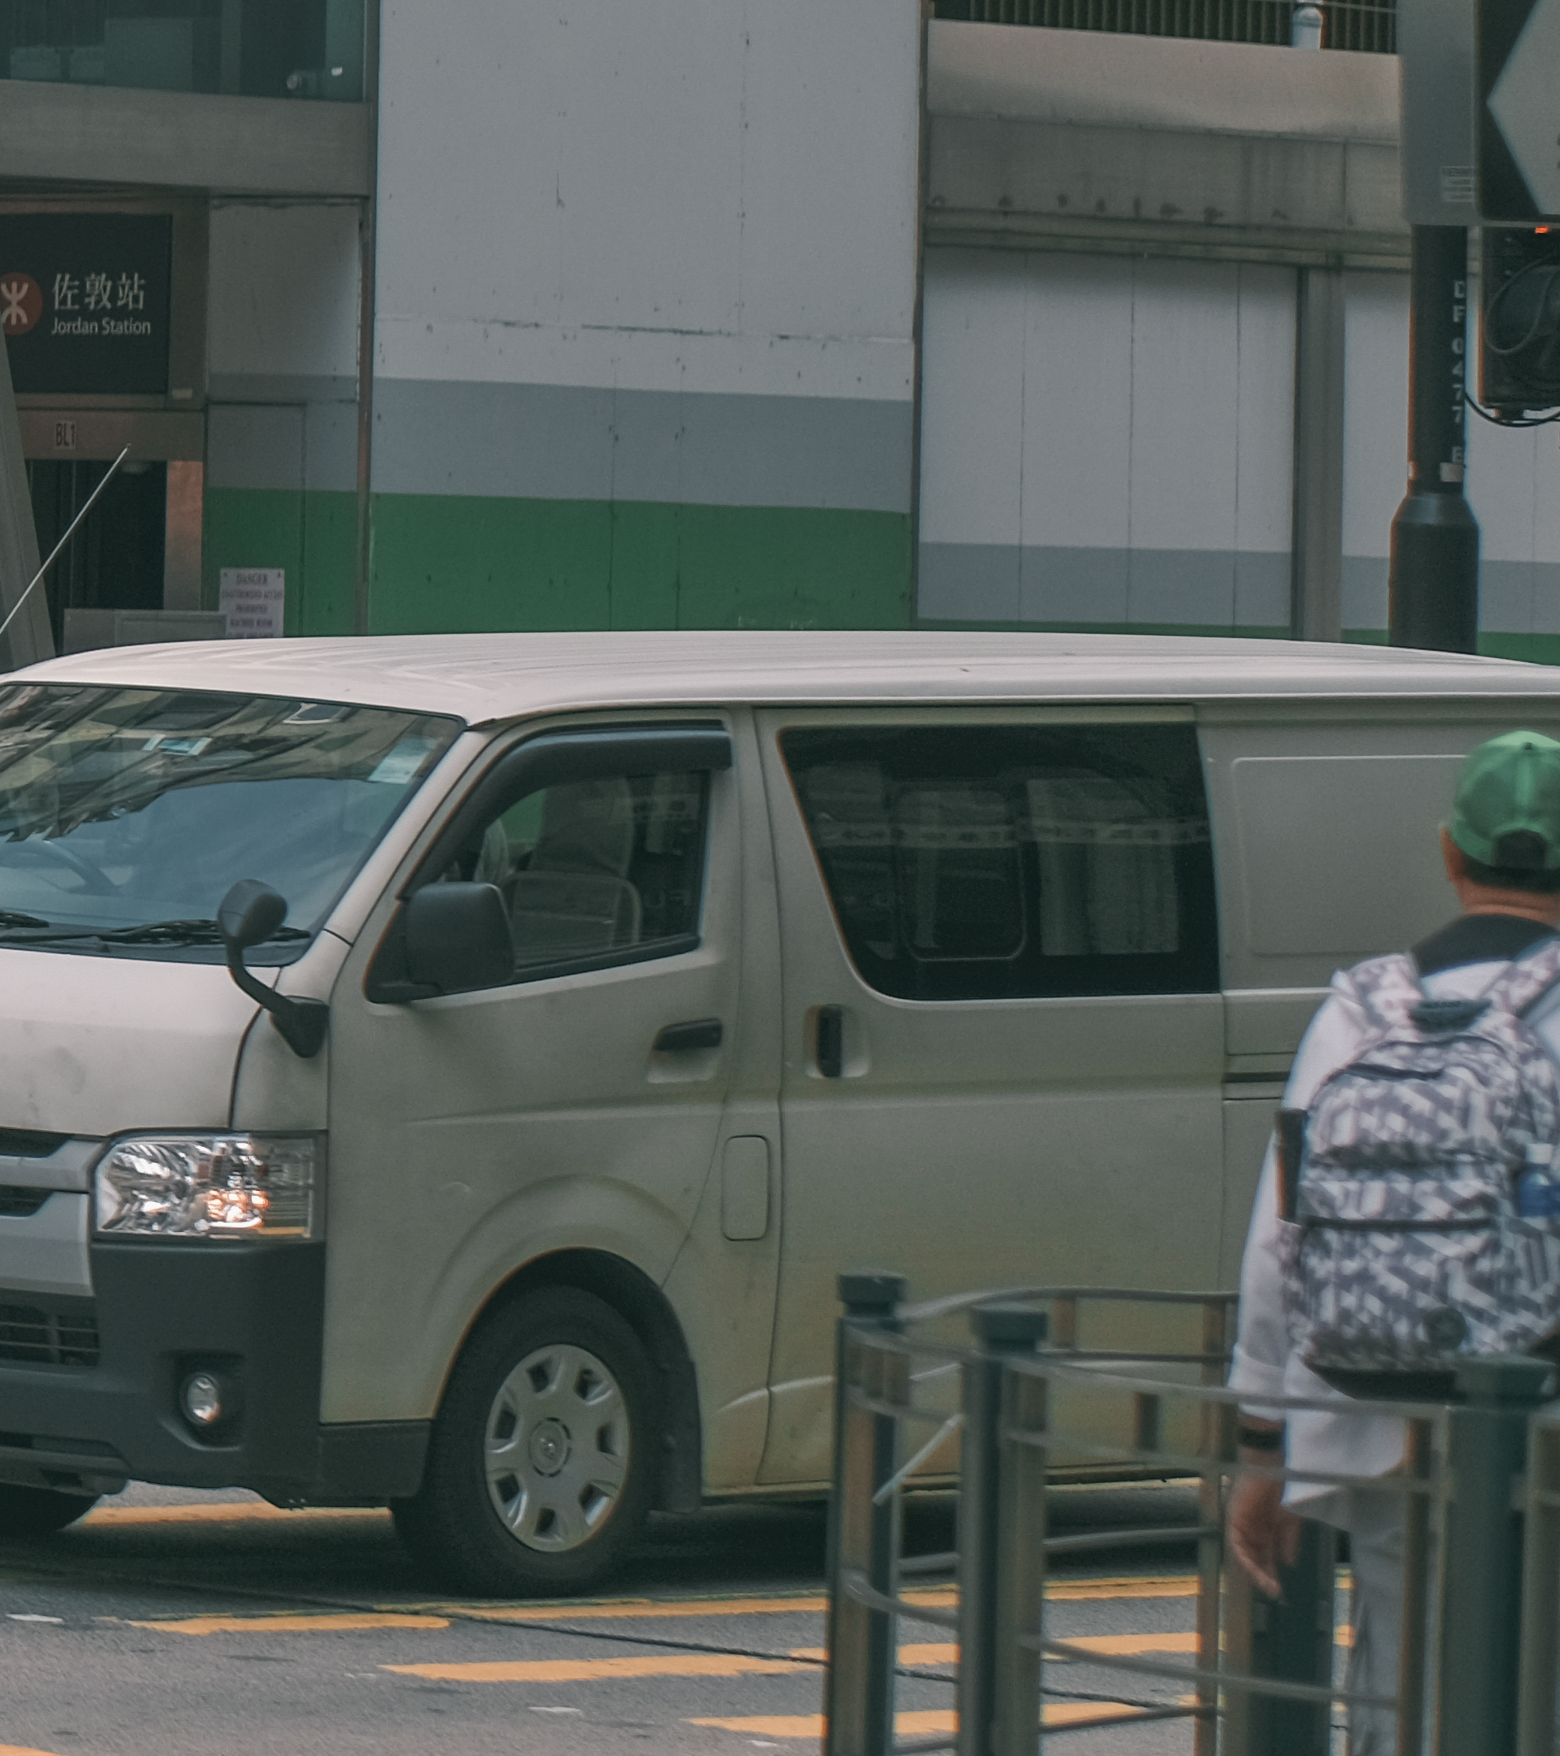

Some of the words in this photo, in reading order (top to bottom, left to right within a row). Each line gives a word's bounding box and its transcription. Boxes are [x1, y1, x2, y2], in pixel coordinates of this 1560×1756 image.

[51, 273, 147, 311] 佐敦站
[51, 317, 98, 336] Jordan
[102, 317, 151, 336] Station
